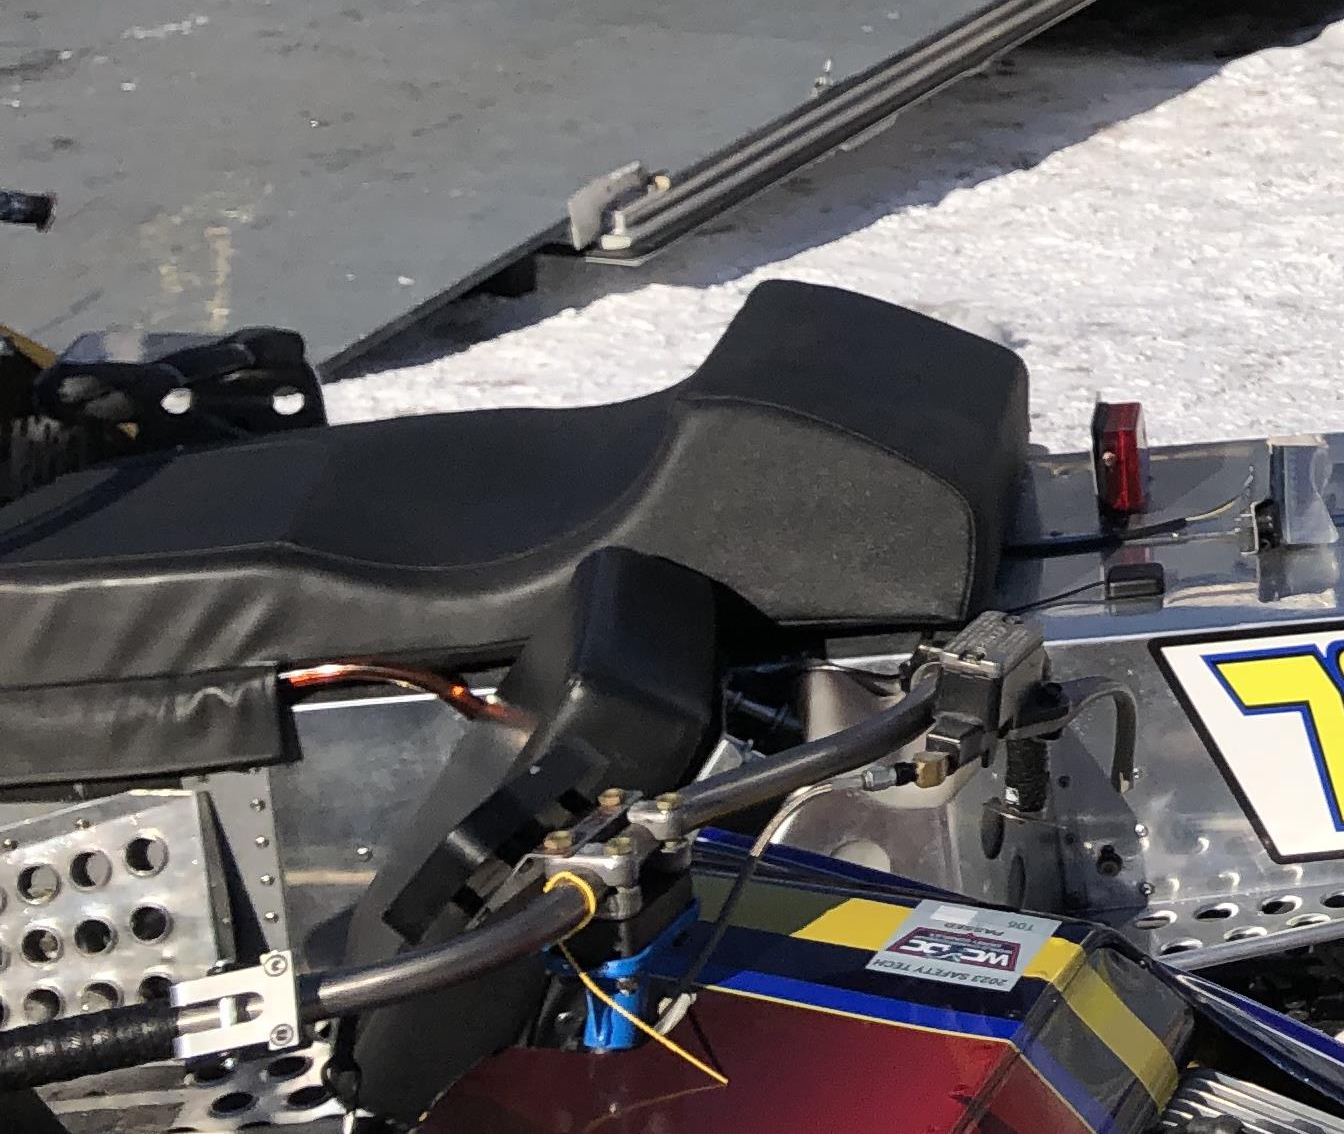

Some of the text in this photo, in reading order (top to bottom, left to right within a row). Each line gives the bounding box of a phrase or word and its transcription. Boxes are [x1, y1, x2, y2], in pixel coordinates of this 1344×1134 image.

[873, 957, 1008, 986] 2023 SAFETY TECH
